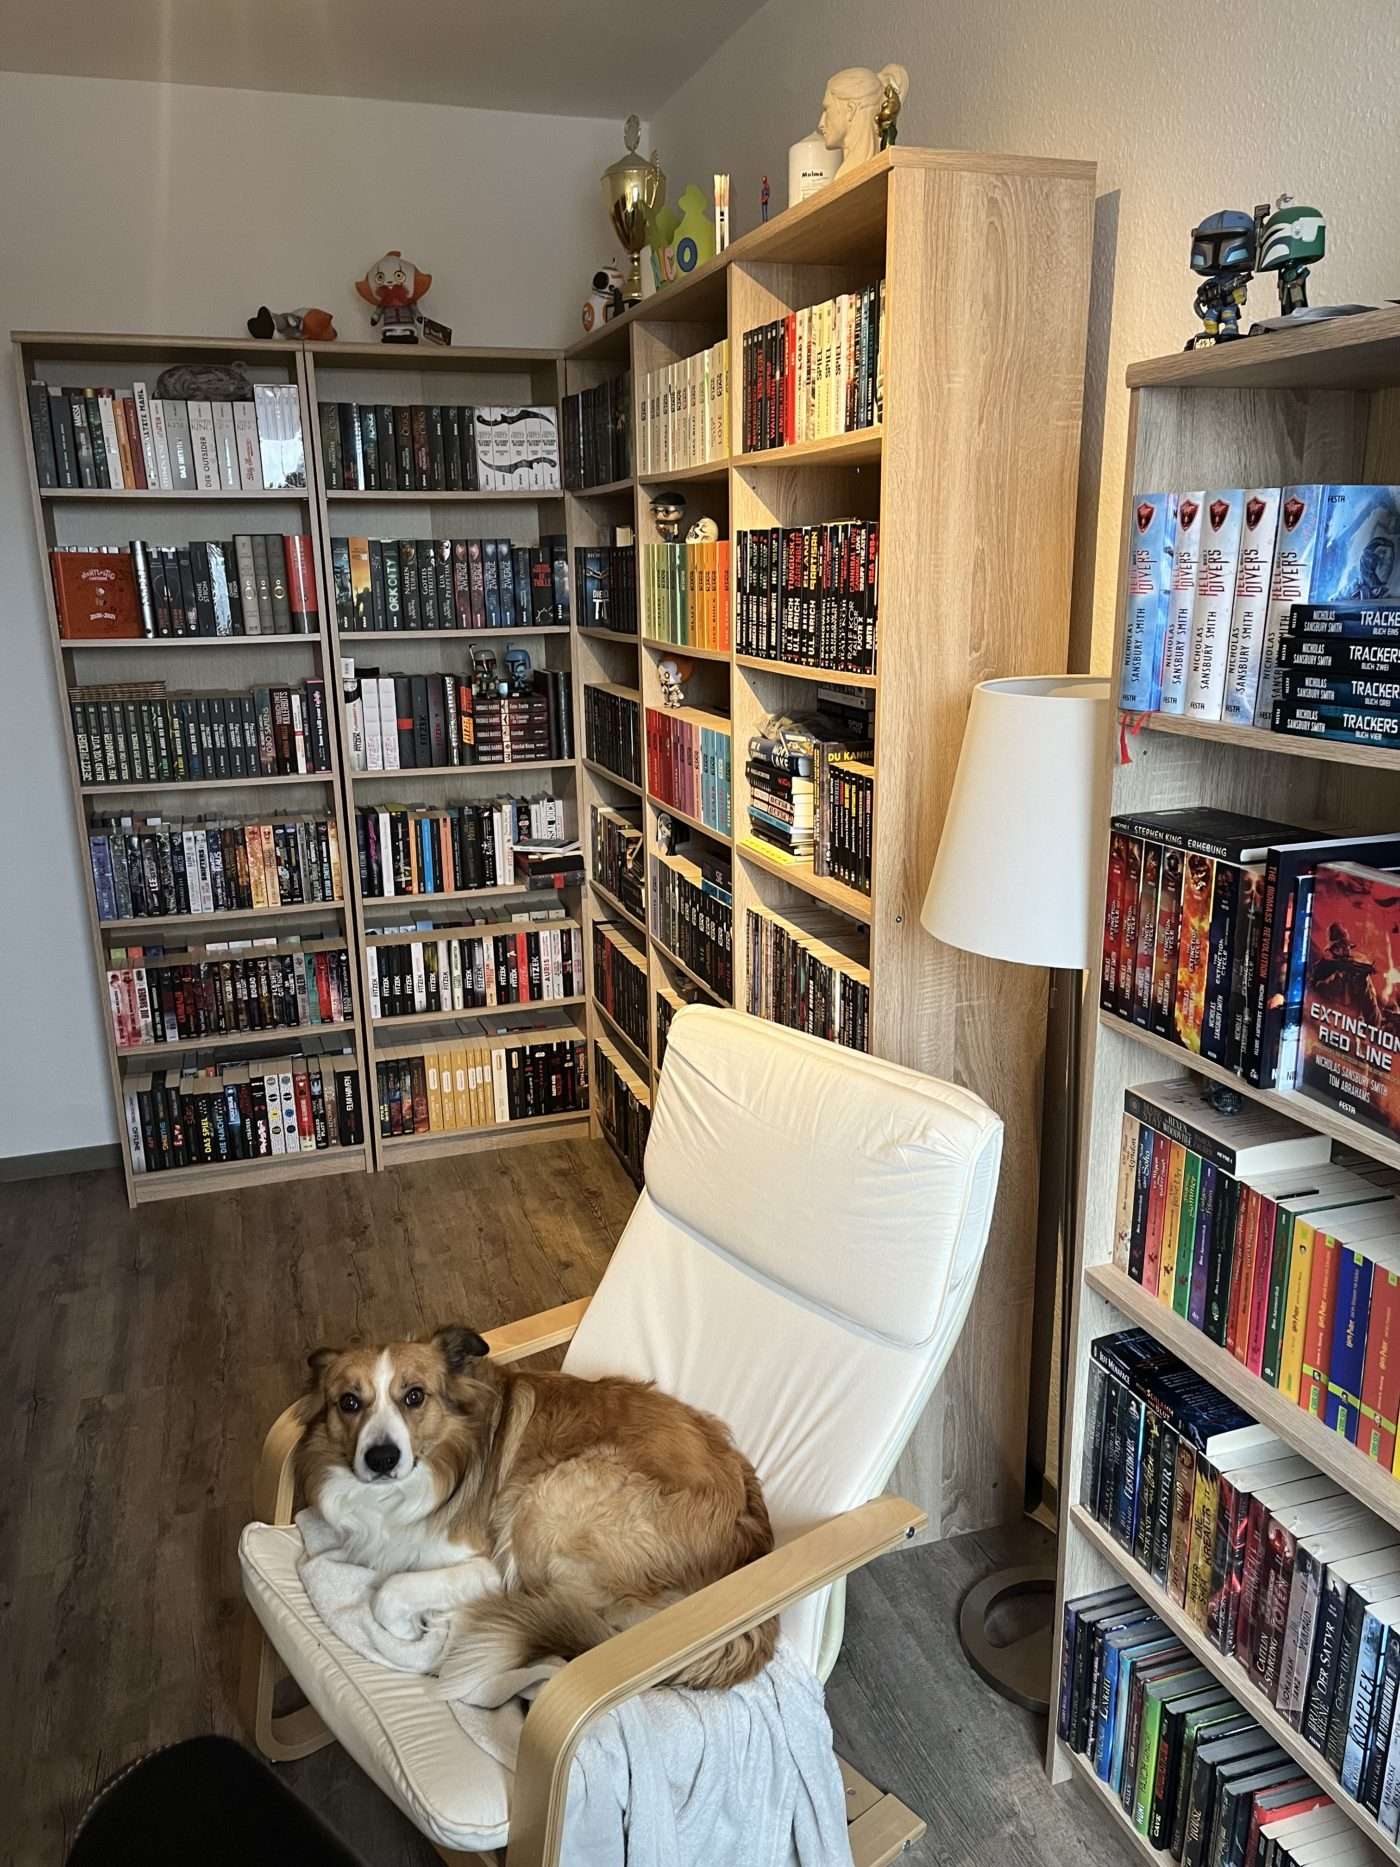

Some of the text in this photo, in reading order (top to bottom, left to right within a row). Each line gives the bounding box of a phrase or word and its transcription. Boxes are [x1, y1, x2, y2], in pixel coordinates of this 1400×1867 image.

[199, 436, 210, 472] OUTSIDER
[459, 562, 468, 591] ZWERGE
[474, 562, 482, 591] ZWERGE
[488, 561, 497, 589] ZWERGE
[502, 561, 512, 589] ZWERGE
[1129, 569, 1141, 596] HELL
[1137, 550, 1155, 591] DIVERS
[1181, 553, 1196, 588] DIVERS
[1198, 569, 1210, 597] HELL
[1207, 550, 1225, 592] DIVERS
[1236, 569, 1247, 598] HELL
[1245, 550, 1263, 592] DIVERS
[1271, 570, 1281, 601] HELL
[1280, 553, 1301, 597] DIVERS
[1303, 622, 1343, 633] SANSBURY SMITH
[1313, 610, 1336, 621] NICHOLAS
[1124, 624, 1134, 666] NICHOLAS
[1131, 608, 1146, 682] SANSBURY SMITH
[1165, 624, 1175, 668] NICHOLAS
[1173, 608, 1188, 685] SANSBURY SMITH
[1193, 627, 1203, 671] NICHOLAS
[1201, 611, 1217, 690] SANSBURY SMITH
[1228, 628, 1239, 674] NICHOLAS
[1236, 611, 1255, 693] SANSBURY SMITH
[1262, 631, 1276, 680] NICHOLAS
[1293, 654, 1332, 667] SANSBURY SMITH
[1302, 643, 1325, 654] NICHOLAS
[1297, 688, 1334, 701] SANSBURY SMITH
[1305, 677, 1327, 688] NICHOLAS
[279, 691, 290, 724] KILLERBOTS
[1296, 709, 1318, 720] NICHOLAS
[1343, 713, 1398, 734] TRACKERS
[1287, 719, 1325, 733] SANSBURY SMITH
[1355, 730, 1368, 738] BUCH
[95, 762, 105, 781] BLIND
[1134, 825, 1165, 840] STEPHEN
[1164, 832, 1183, 845] KING
[1187, 839, 1227, 857] ERHEBUNG
[149, 878, 159, 892] LEE
[1268, 866, 1278, 881] THE
[1263, 885, 1275, 922] BIOMASS
[1215, 938, 1224, 984] EXTINCTION
[1258, 927, 1272, 979] REVOLUTION
[405, 974, 413, 994] FITZEK
[429, 973, 437, 992] FITZEK
[465, 968, 473, 989] FITZEK
[532, 956, 540, 984] FITZEK
[543, 959, 551, 982] AURIS
[1214, 1012, 1222, 1040] SANSBURY
[1310, 1003, 1400, 1053] EXTINCTION
[1318, 1025, 1392, 1071] RED LINE
[1315, 1055, 1389, 1096] NICHOLAS SANSBURY SMITH
[1329, 1074, 1371, 1103] TOM ABRAHAMS
[132, 1127, 140, 1151] OFFLINE
[201, 1118, 211, 1149] DAS SPIEL
[216, 1115, 227, 1150] DIE NACHT
[1159, 1467, 1172, 1528] BLISTER
[1193, 1516, 1203, 1538] DIE
[1202, 1505, 1212, 1566] KREATUR
[1256, 1632, 1269, 1673] CAITLIN
[1264, 1637, 1279, 1686] STARLING
[1317, 1620, 1334, 1695] DER SATYR
[1308, 1694, 1320, 1732] BRIAN
[1317, 1700, 1330, 1740] KEENE
[1351, 1669, 1375, 1750] KOMPLEX
